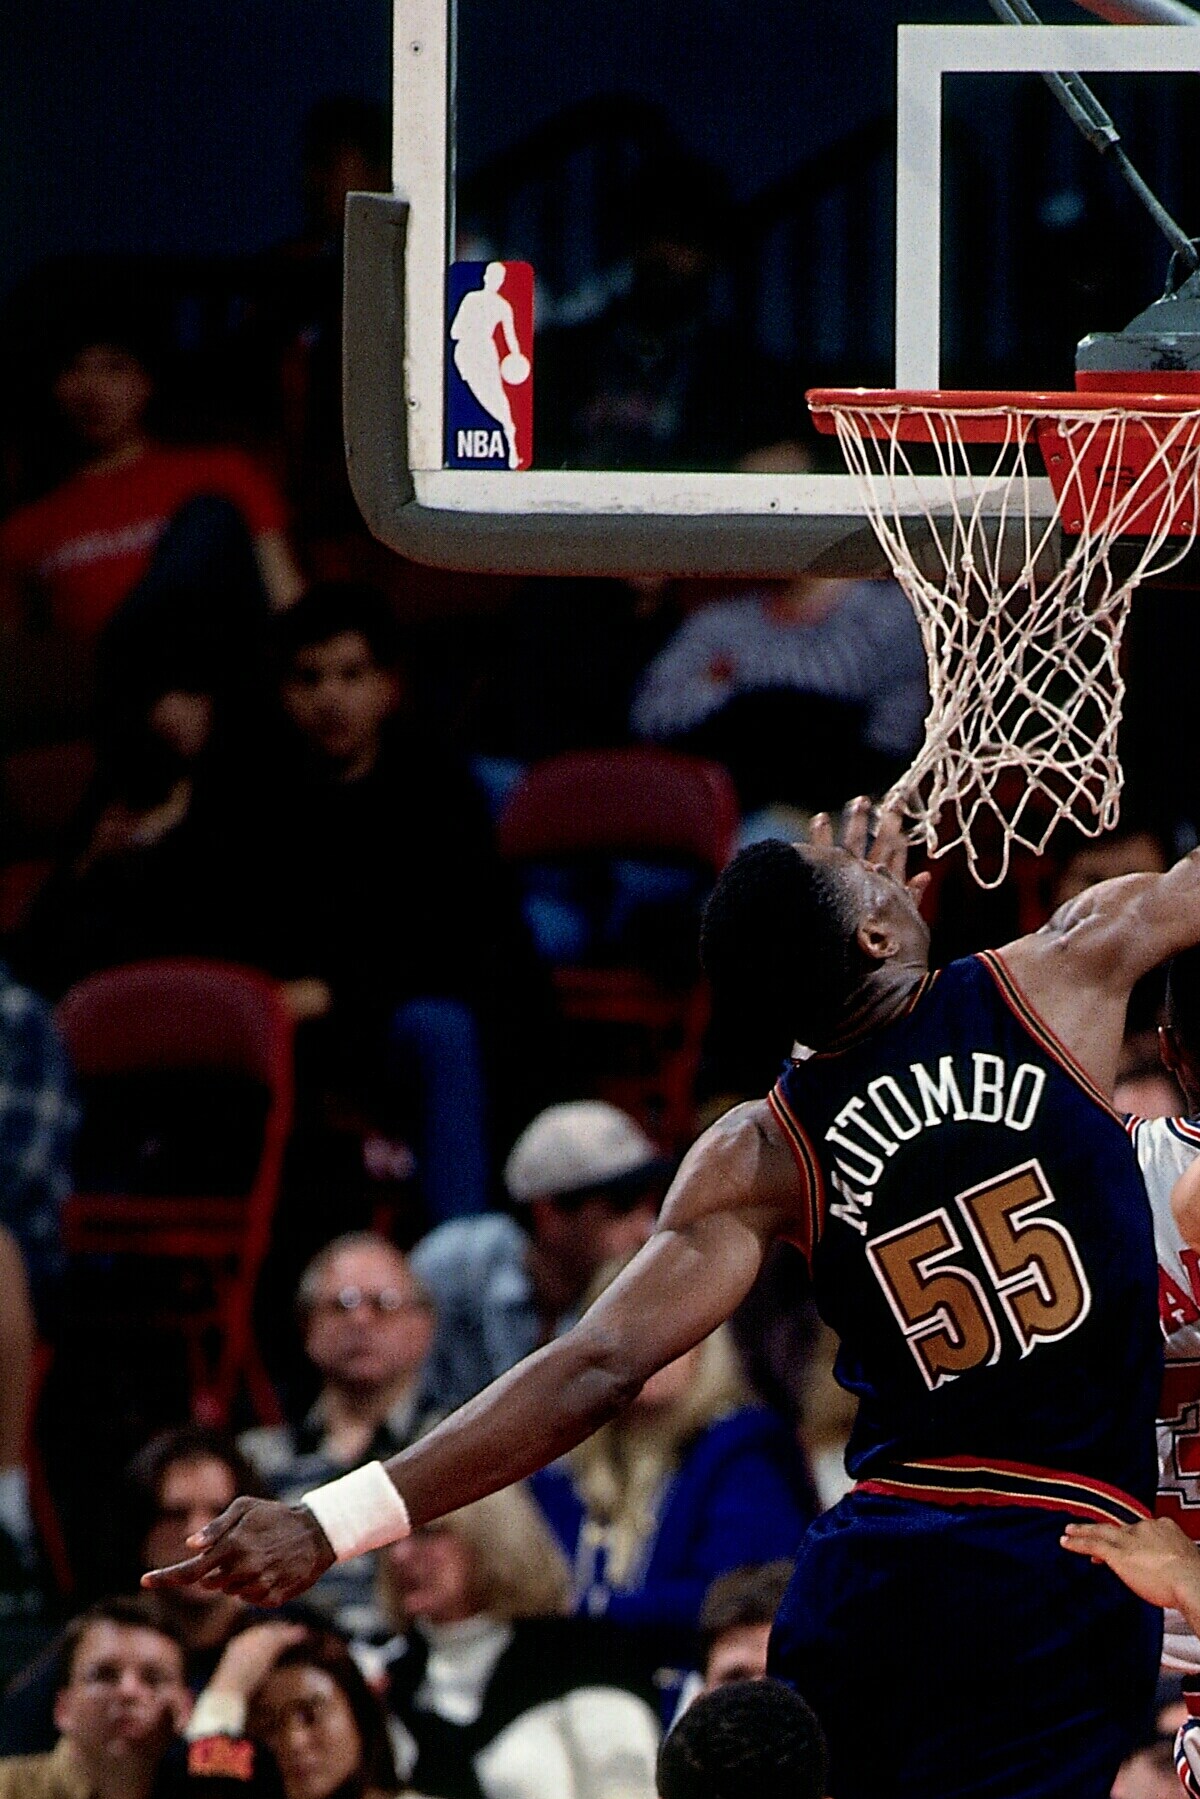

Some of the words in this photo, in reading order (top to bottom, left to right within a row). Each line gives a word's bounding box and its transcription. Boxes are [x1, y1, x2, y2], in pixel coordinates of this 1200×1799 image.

[457, 429, 505, 458] NBA
[824, 1052, 1046, 1236] MUTOMBO
[865, 1158, 1092, 1391] 55
